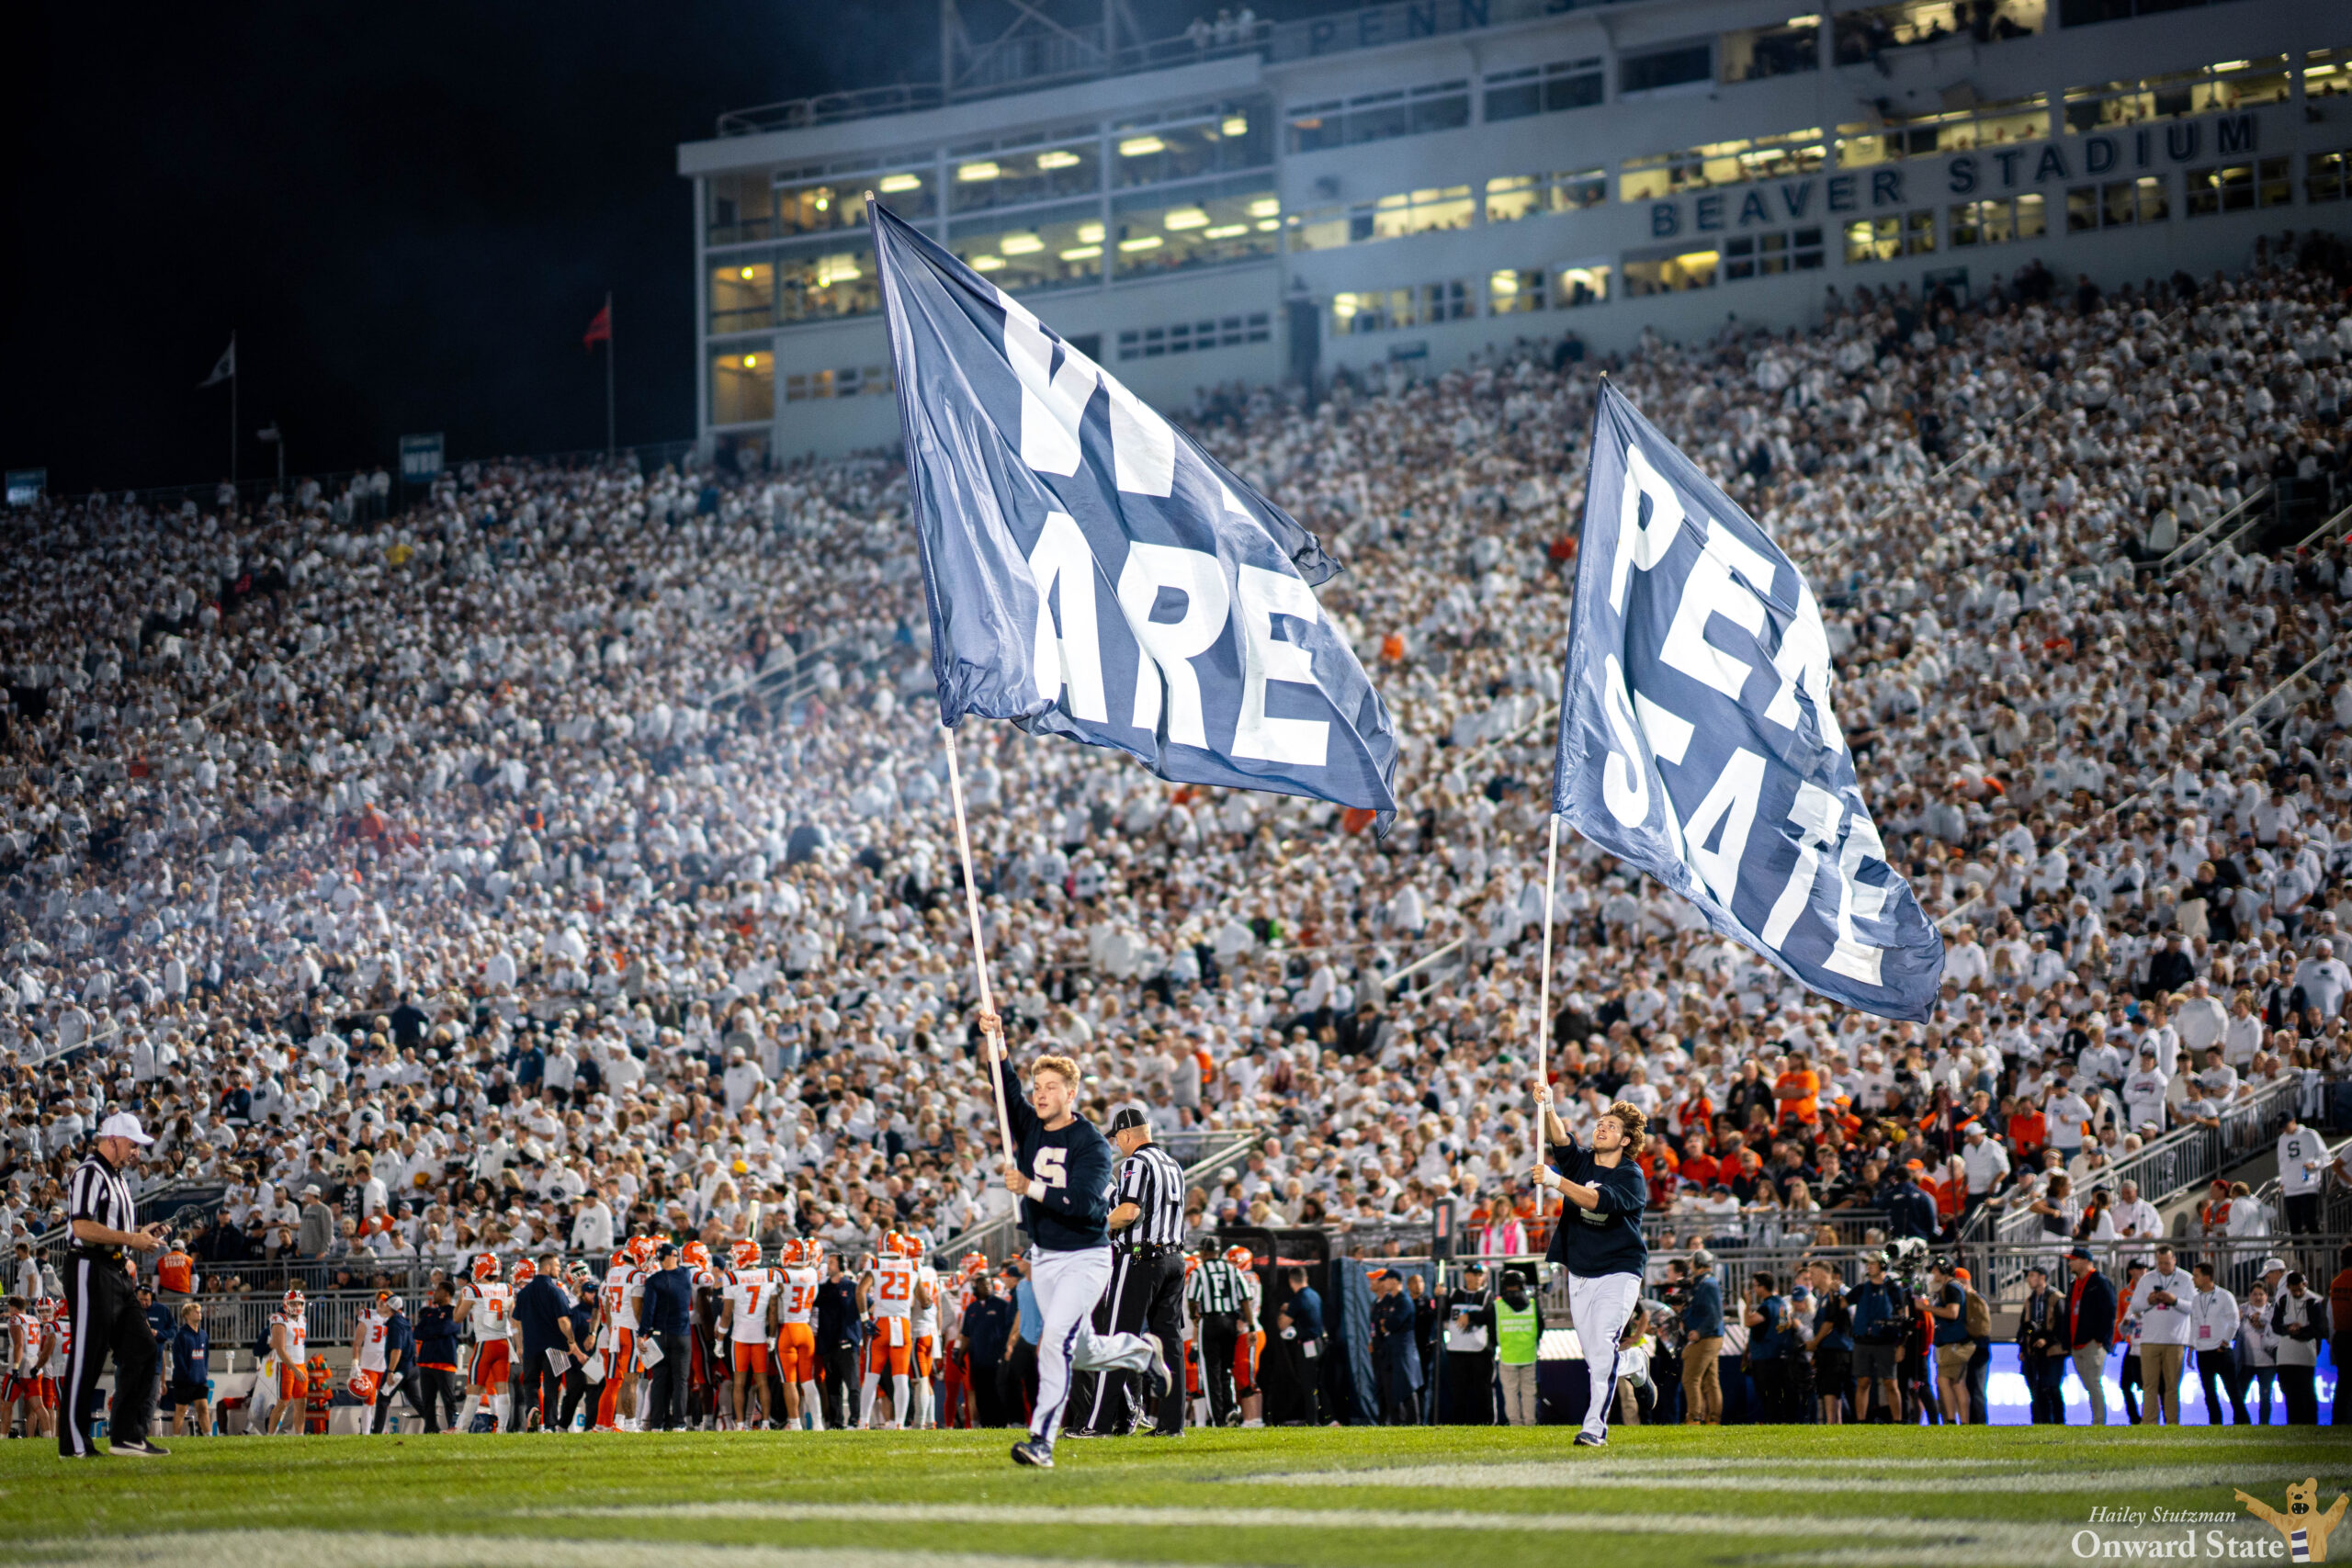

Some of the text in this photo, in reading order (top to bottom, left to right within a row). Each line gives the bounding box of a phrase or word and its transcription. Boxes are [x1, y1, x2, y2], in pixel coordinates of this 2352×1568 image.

[1652, 113, 2255, 237] BEAVER STADIUM
[1027, 511, 1331, 767] ARE
[2287, 1141, 2301, 1158] S
[1033, 1146, 1068, 1189] S
[1437, 1205, 1448, 1238] 1
[880, 1271, 910, 1301] 23
[1210, 1272, 1227, 1297] F
[489, 1298, 503, 1322] 9
[746, 1285, 761, 1314] 7
[787, 1285, 815, 1314] 34
